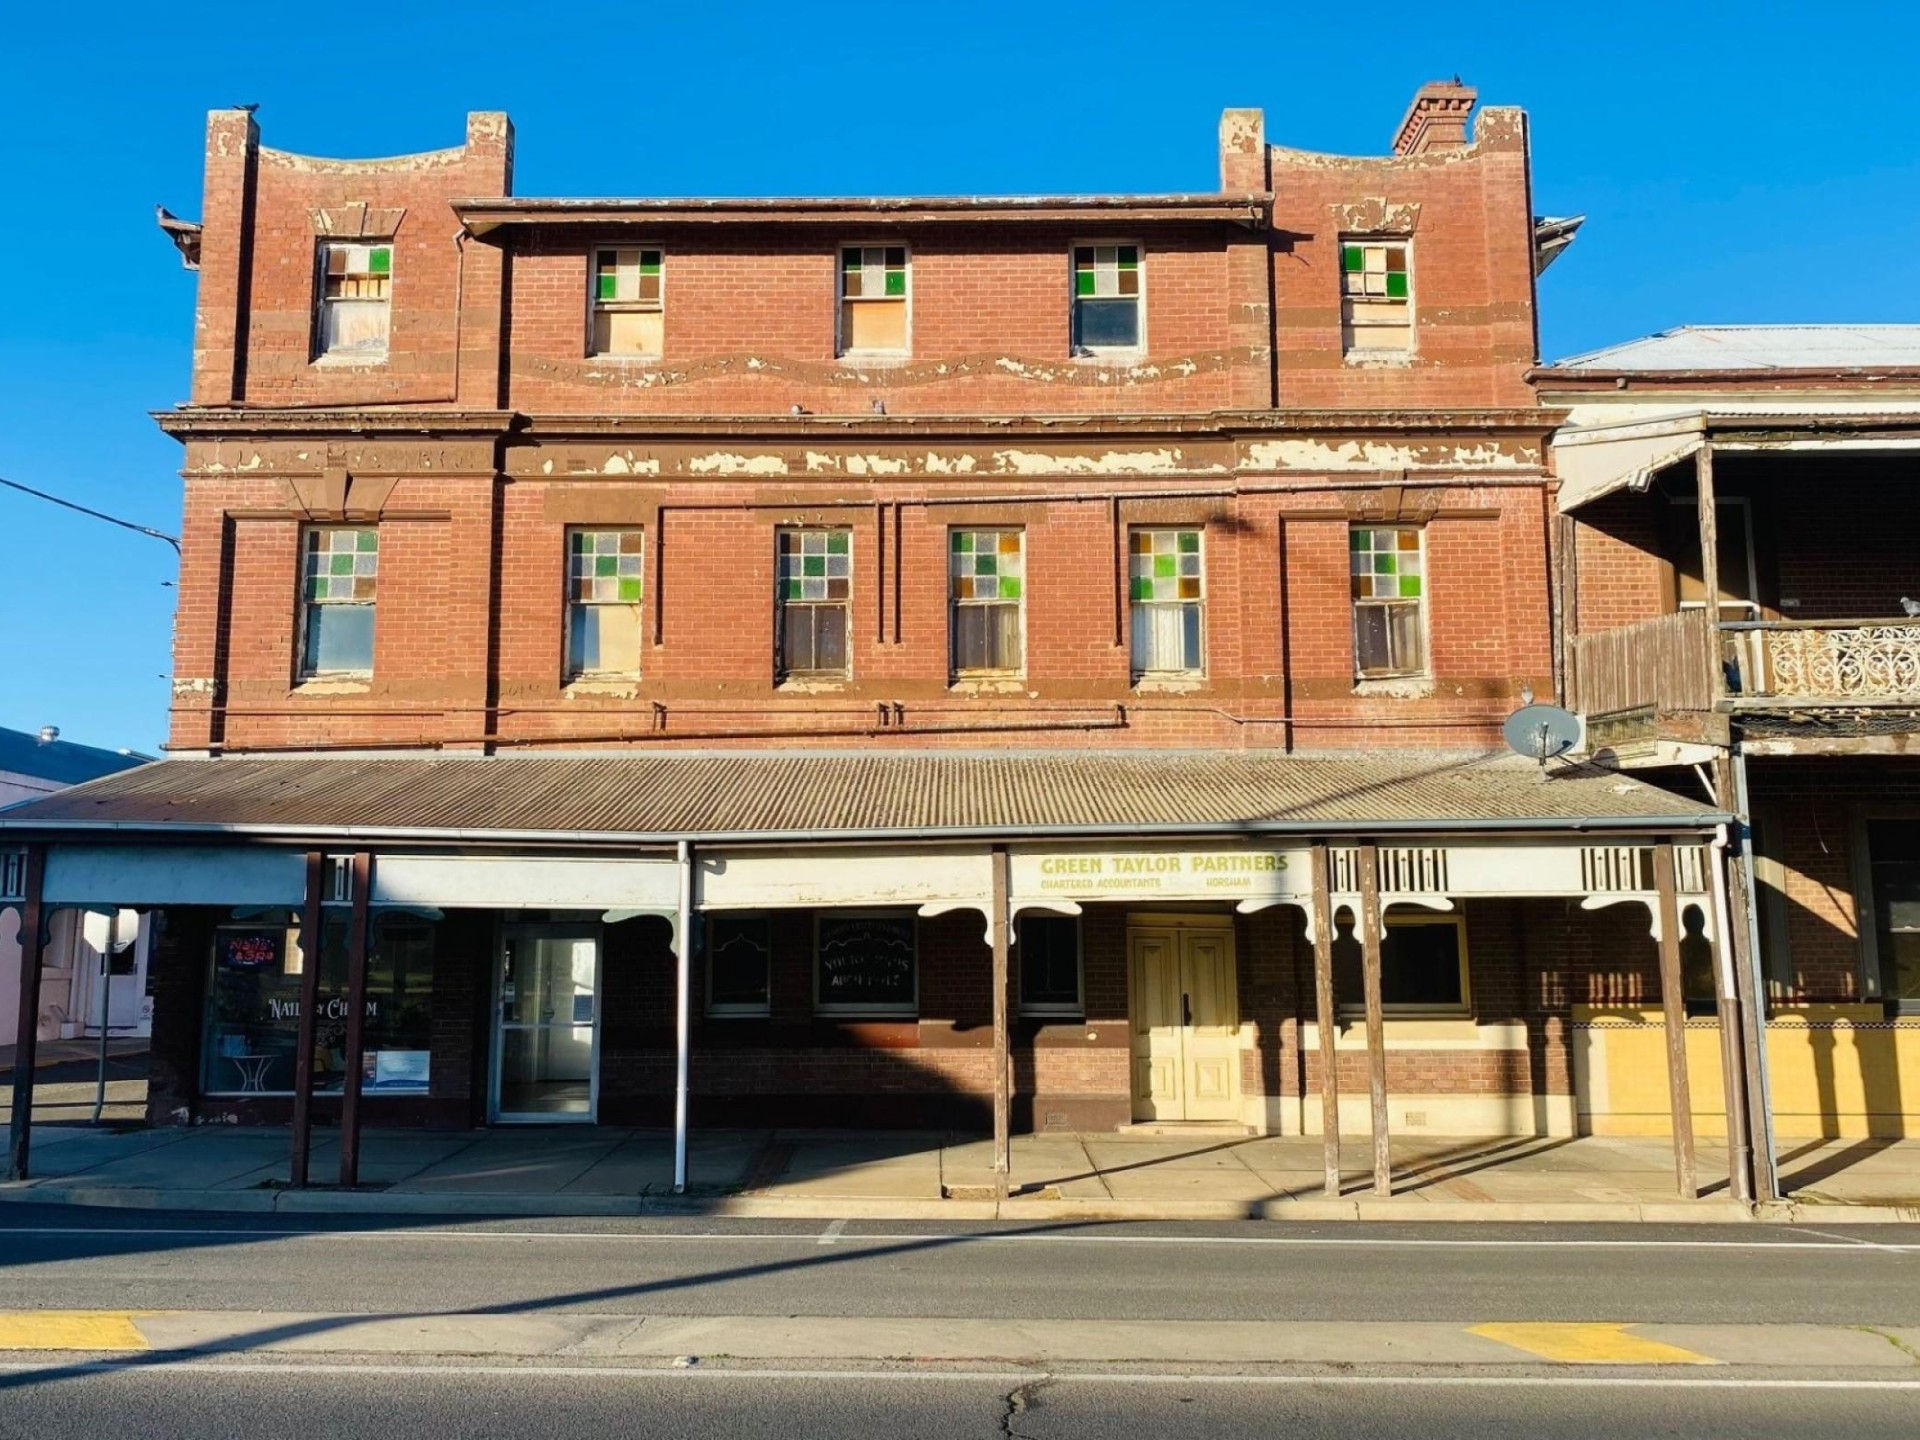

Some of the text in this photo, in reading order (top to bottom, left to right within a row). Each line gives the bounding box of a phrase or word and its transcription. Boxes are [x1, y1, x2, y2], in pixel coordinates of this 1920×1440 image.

[1041, 855, 1289, 874] GREEN TAYLOR PARTNERS
[1041, 877, 1252, 889] CHARTERED ACCOUNTANTS HORSHAM
[230, 939, 268, 950] Nails
[327, 998, 377, 1020] CHM
